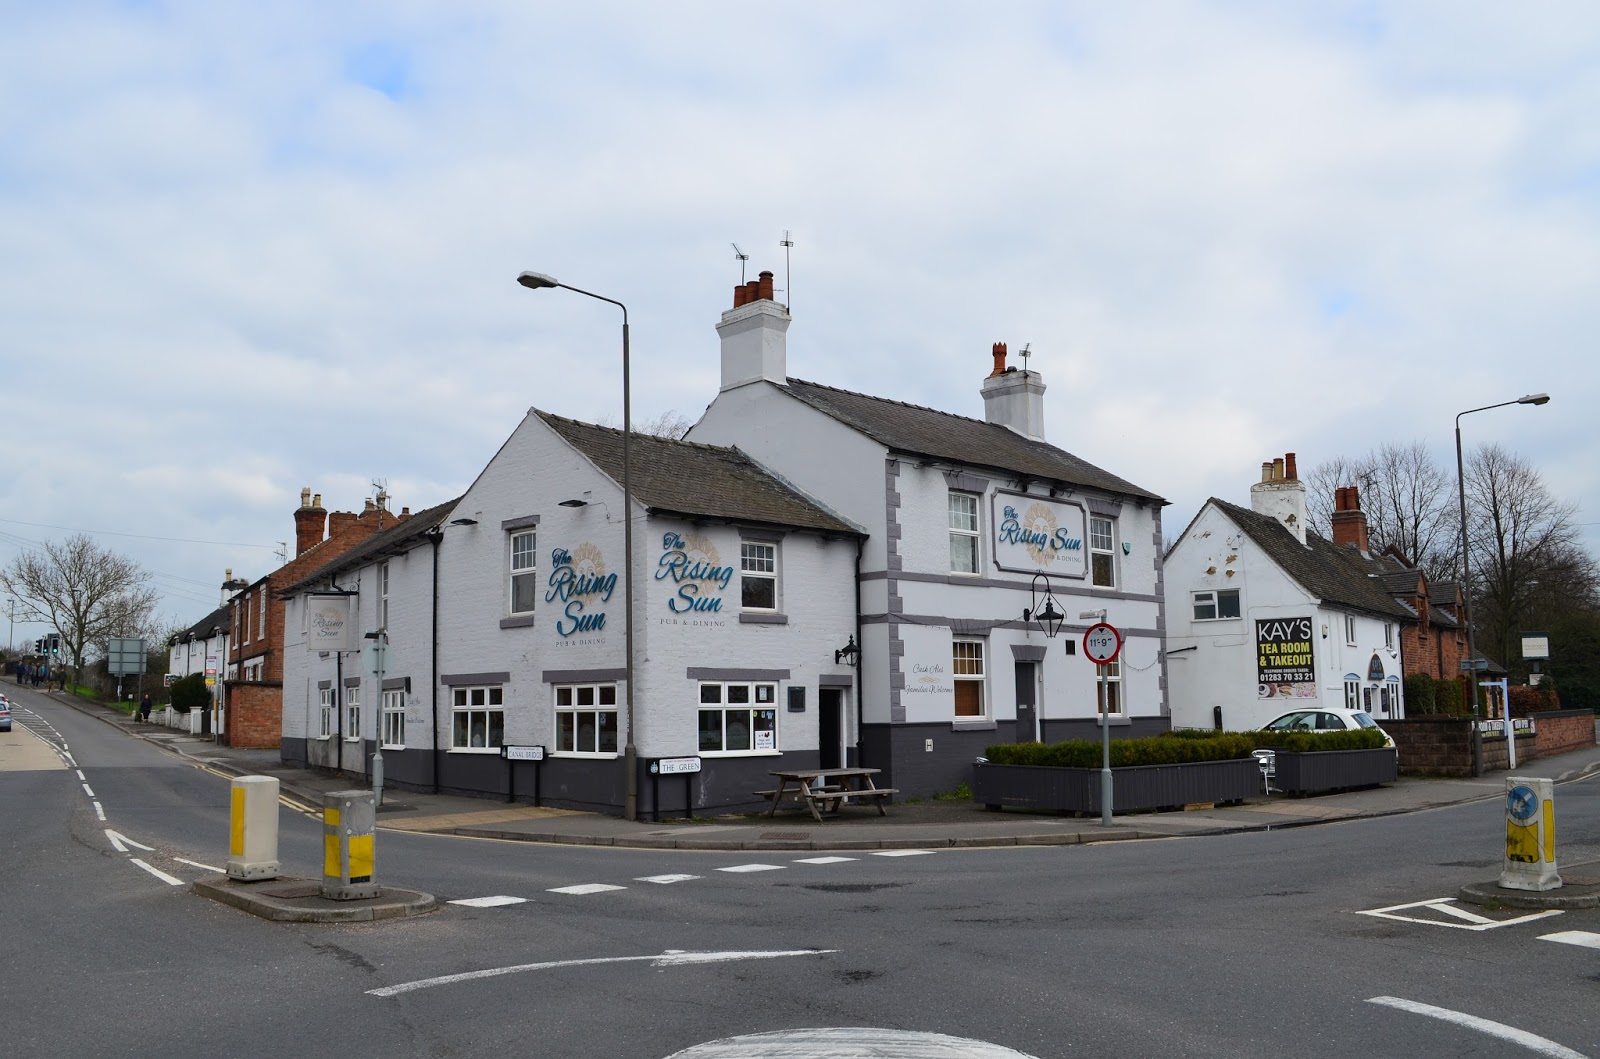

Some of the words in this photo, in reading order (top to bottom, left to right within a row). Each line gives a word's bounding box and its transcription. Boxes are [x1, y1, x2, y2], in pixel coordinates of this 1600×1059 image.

[1003, 505, 1019, 519] The
[663, 532, 686, 550] The
[999, 519, 1048, 552] Rising
[1051, 527, 1082, 550] Sun
[552, 548, 572, 568] The
[655, 550, 734, 590] Rising
[545, 566, 618, 602] Rising
[668, 583, 723, 614] Sun
[312, 618, 344, 629] Rising
[556, 600, 606, 637] Sun
[317, 627, 339, 637] Sun
[1258, 619, 1312, 641] KAY'S
[1260, 644, 1278, 654] TEA
[1281, 642, 1310, 653] ROOM
[913, 663, 928, 673] Cask
[1260, 656, 1267, 666] &
[1269, 655, 1312, 666] TAKEOUT
[679, 763, 700, 771] GREEN
